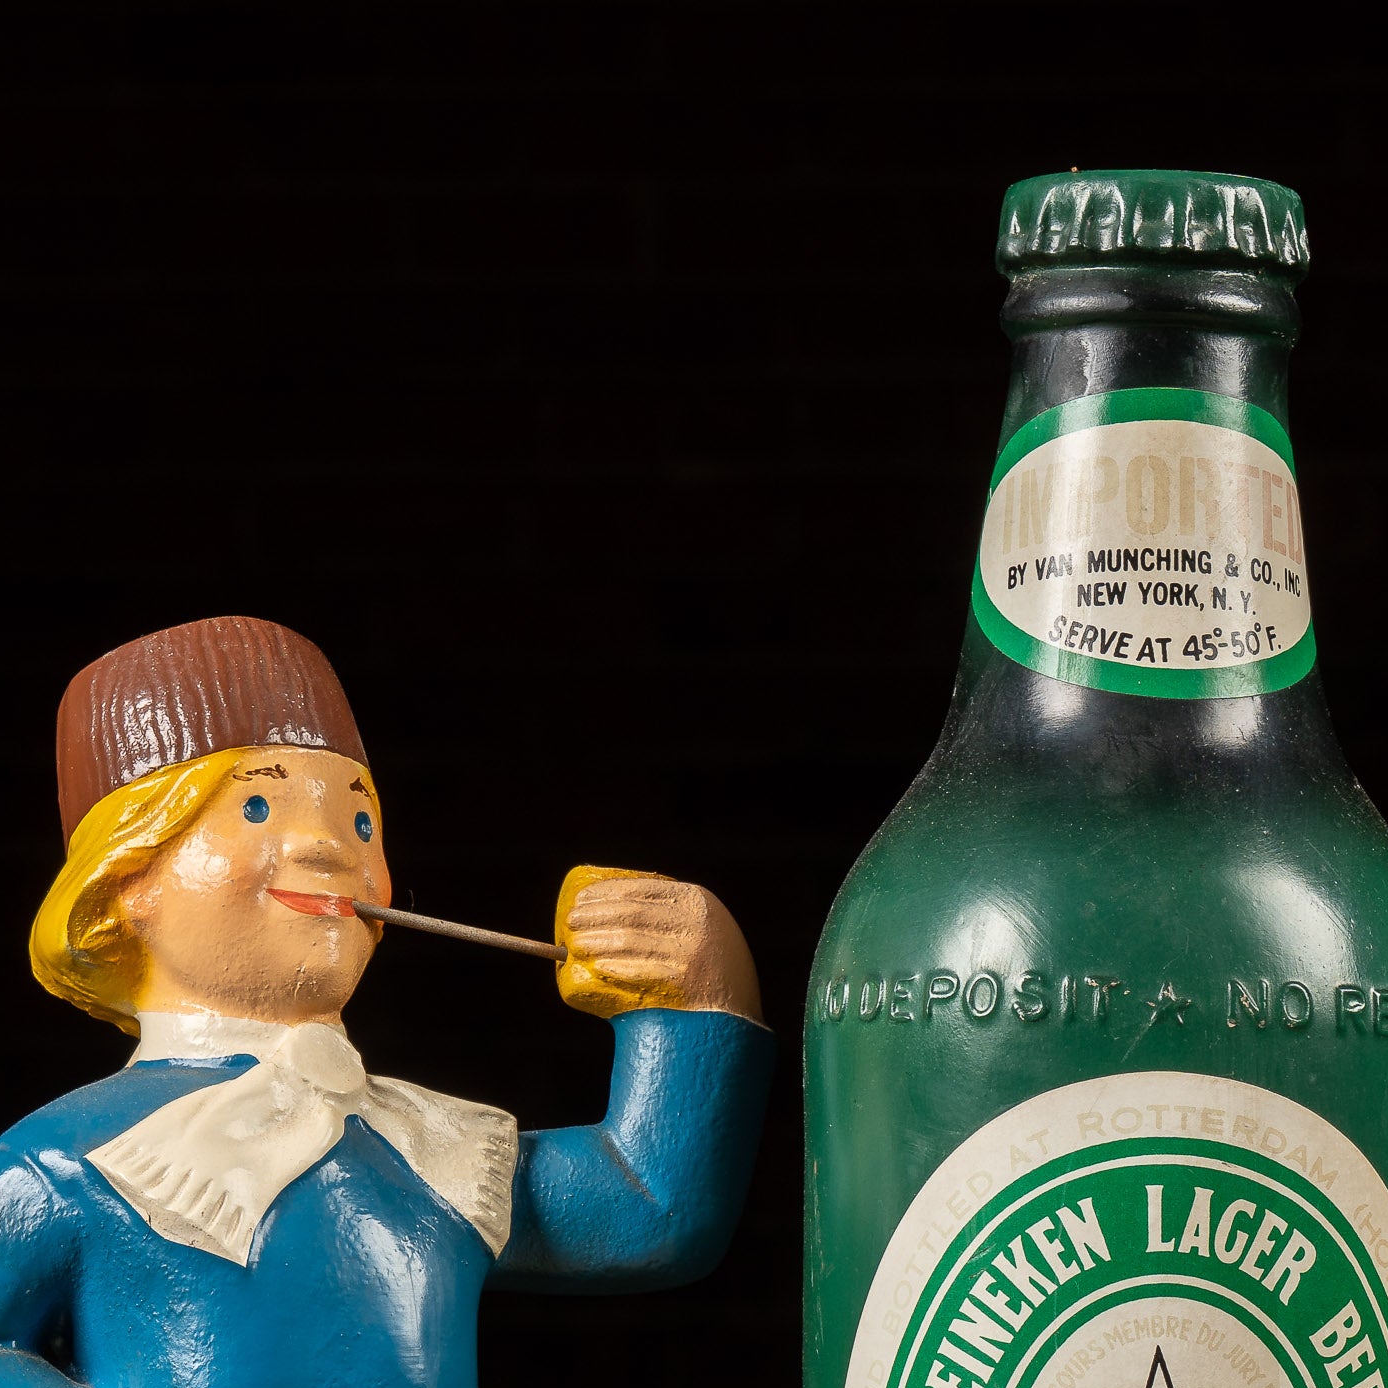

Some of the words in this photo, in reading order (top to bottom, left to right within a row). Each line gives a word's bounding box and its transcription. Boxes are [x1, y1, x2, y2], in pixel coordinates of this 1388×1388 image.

[1002, 455, 1303, 566] IMPORTED
[1007, 561, 1028, 590] BY
[1034, 553, 1074, 581] VAN
[1087, 547, 1213, 575] MUNCHING
[1224, 552, 1240, 578] &
[1250, 557, 1281, 592] CO.,
[1284, 567, 1302, 598] INC
[1076, 581, 1127, 608] NEW
[1137, 581, 1205, 611] YORK,
[1212, 586, 1233, 612] N.
[1239, 590, 1256, 616] Y.
[1047, 615, 1133, 659] SERVE
[1136, 637, 1172, 664] AT
[1265, 625, 1283, 651] F.
[859, 968, 1121, 1024] DEPOSIT
[1225, 976, 1315, 1030] NO
[881, 1170, 995, 1336] BOTTLED
[1010, 1127, 1051, 1172] AT
[1075, 1103, 1340, 1190] ROTTERDAM
[1144, 1184, 1317, 1307] LAGER
[1102, 1315, 1193, 1352] MEMBRE
[1195, 1321, 1226, 1352] DU
[1222, 1343, 1268, 1387] JURY
